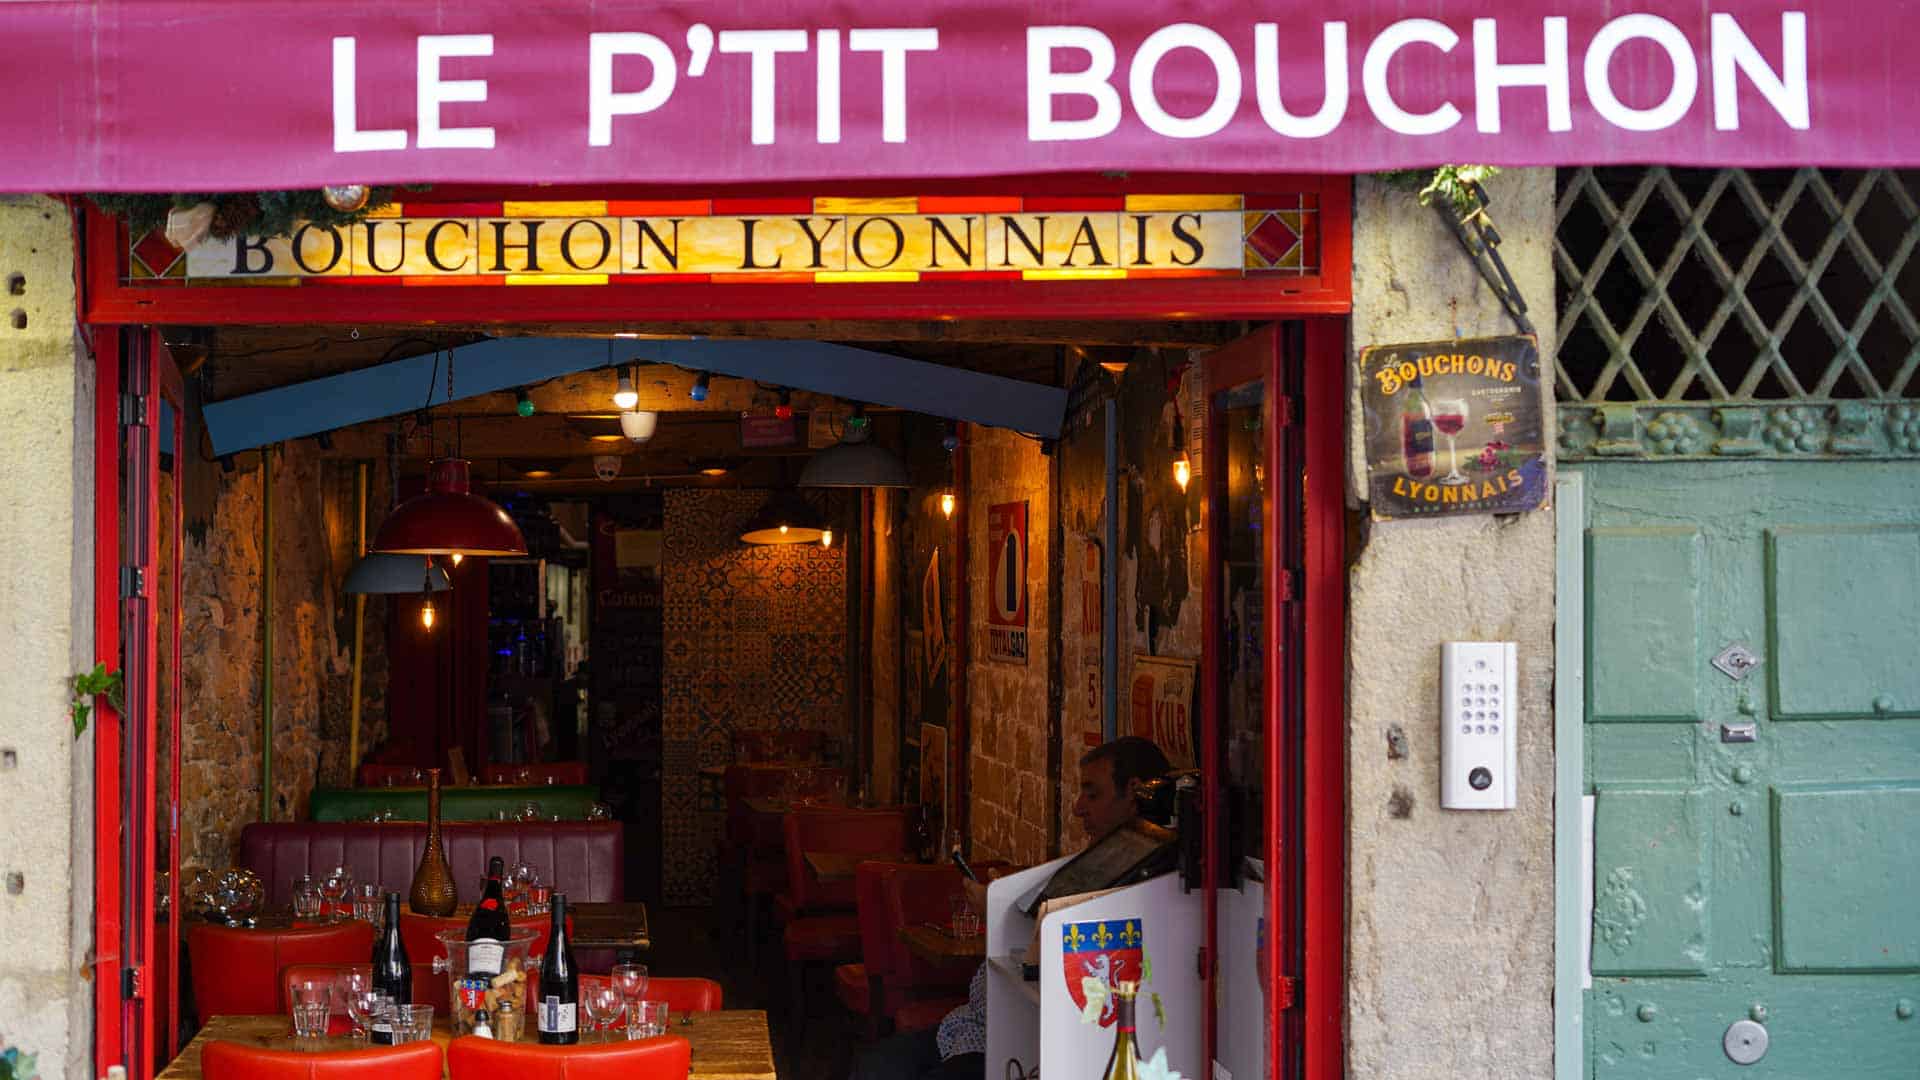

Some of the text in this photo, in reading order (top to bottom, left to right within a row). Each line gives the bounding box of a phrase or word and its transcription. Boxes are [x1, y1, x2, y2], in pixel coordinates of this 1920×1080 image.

[333, 12, 1809, 153] LE P’TIT BOUCHON
[230, 213, 1204, 275] BOUCHON LYONNAIS
[1375, 353, 1517, 396] BOUCHONS
[1393, 468, 1524, 503] LYONNAIS
[1155, 700, 1189, 755] KUB
